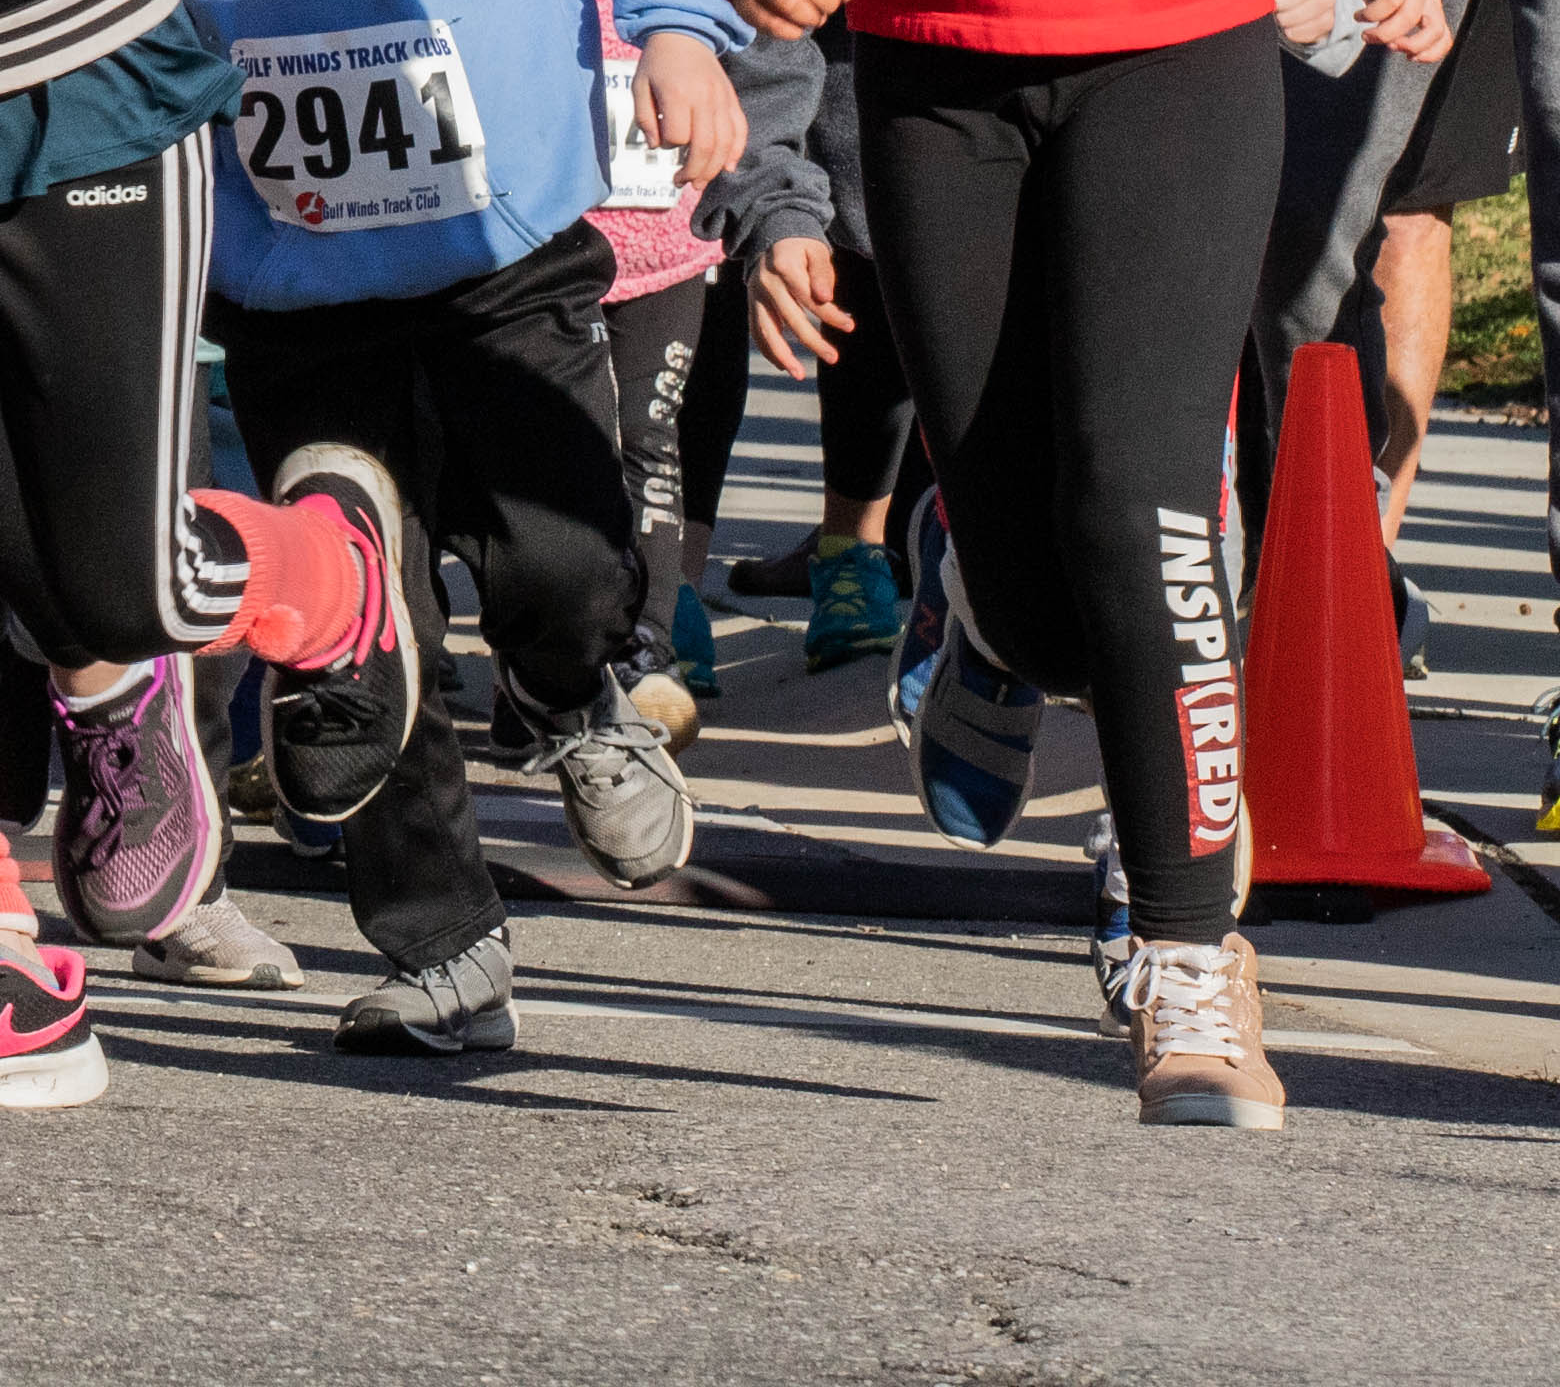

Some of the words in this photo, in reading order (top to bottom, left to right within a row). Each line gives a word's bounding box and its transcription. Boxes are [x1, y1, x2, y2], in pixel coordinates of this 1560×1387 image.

[277, 51, 341, 76] WINDS
[346, 41, 409, 69] TRACK
[414, 37, 452, 58] CLUB
[239, 71, 472, 180] 2941
[66, 184, 148, 206] adidas
[322, 201, 344, 220] Gulf
[346, 200, 379, 218] Winds
[383, 197, 412, 214] Track
[416, 194, 440, 211] Club
